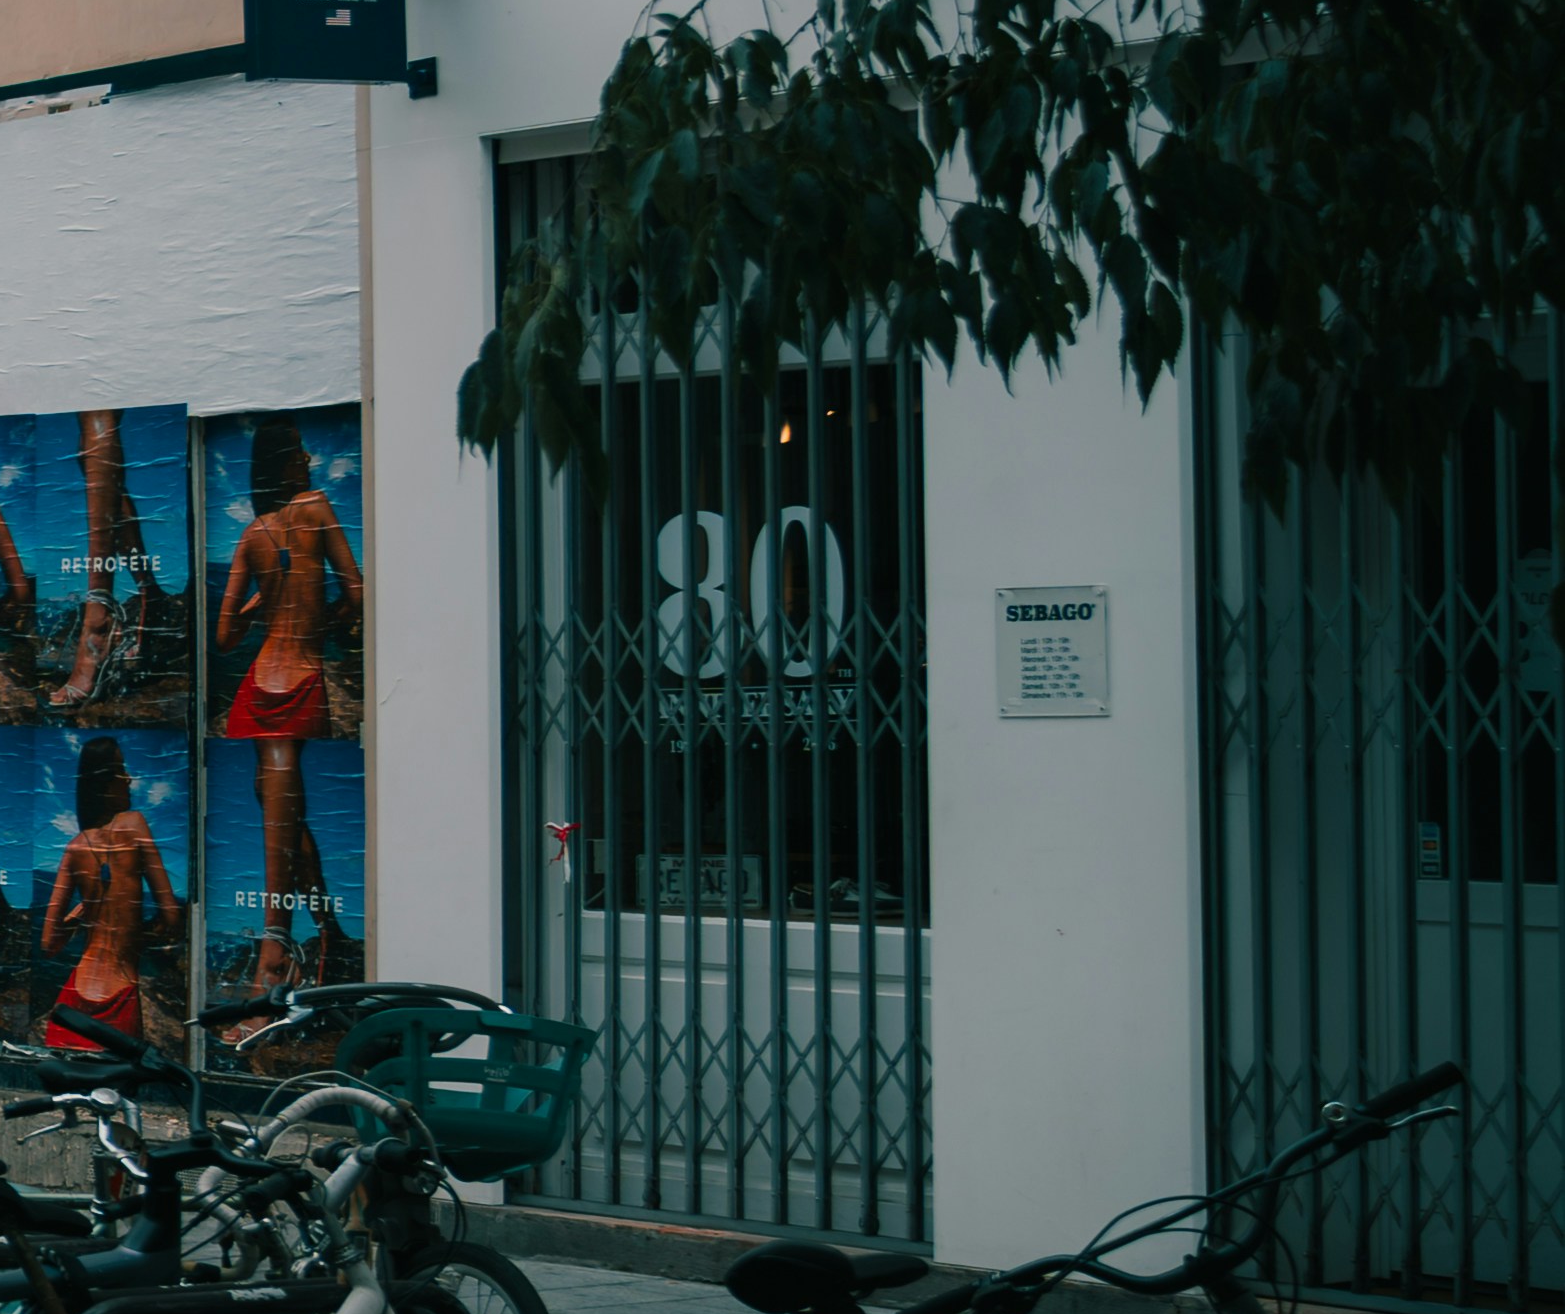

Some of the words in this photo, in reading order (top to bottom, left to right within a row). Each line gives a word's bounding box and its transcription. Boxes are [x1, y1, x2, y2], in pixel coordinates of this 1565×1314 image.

[60, 548, 162, 574] RETROFÊTE
[1006, 603, 1093, 622] SEBAGO
[235, 887, 344, 914] RETROFÊTE
